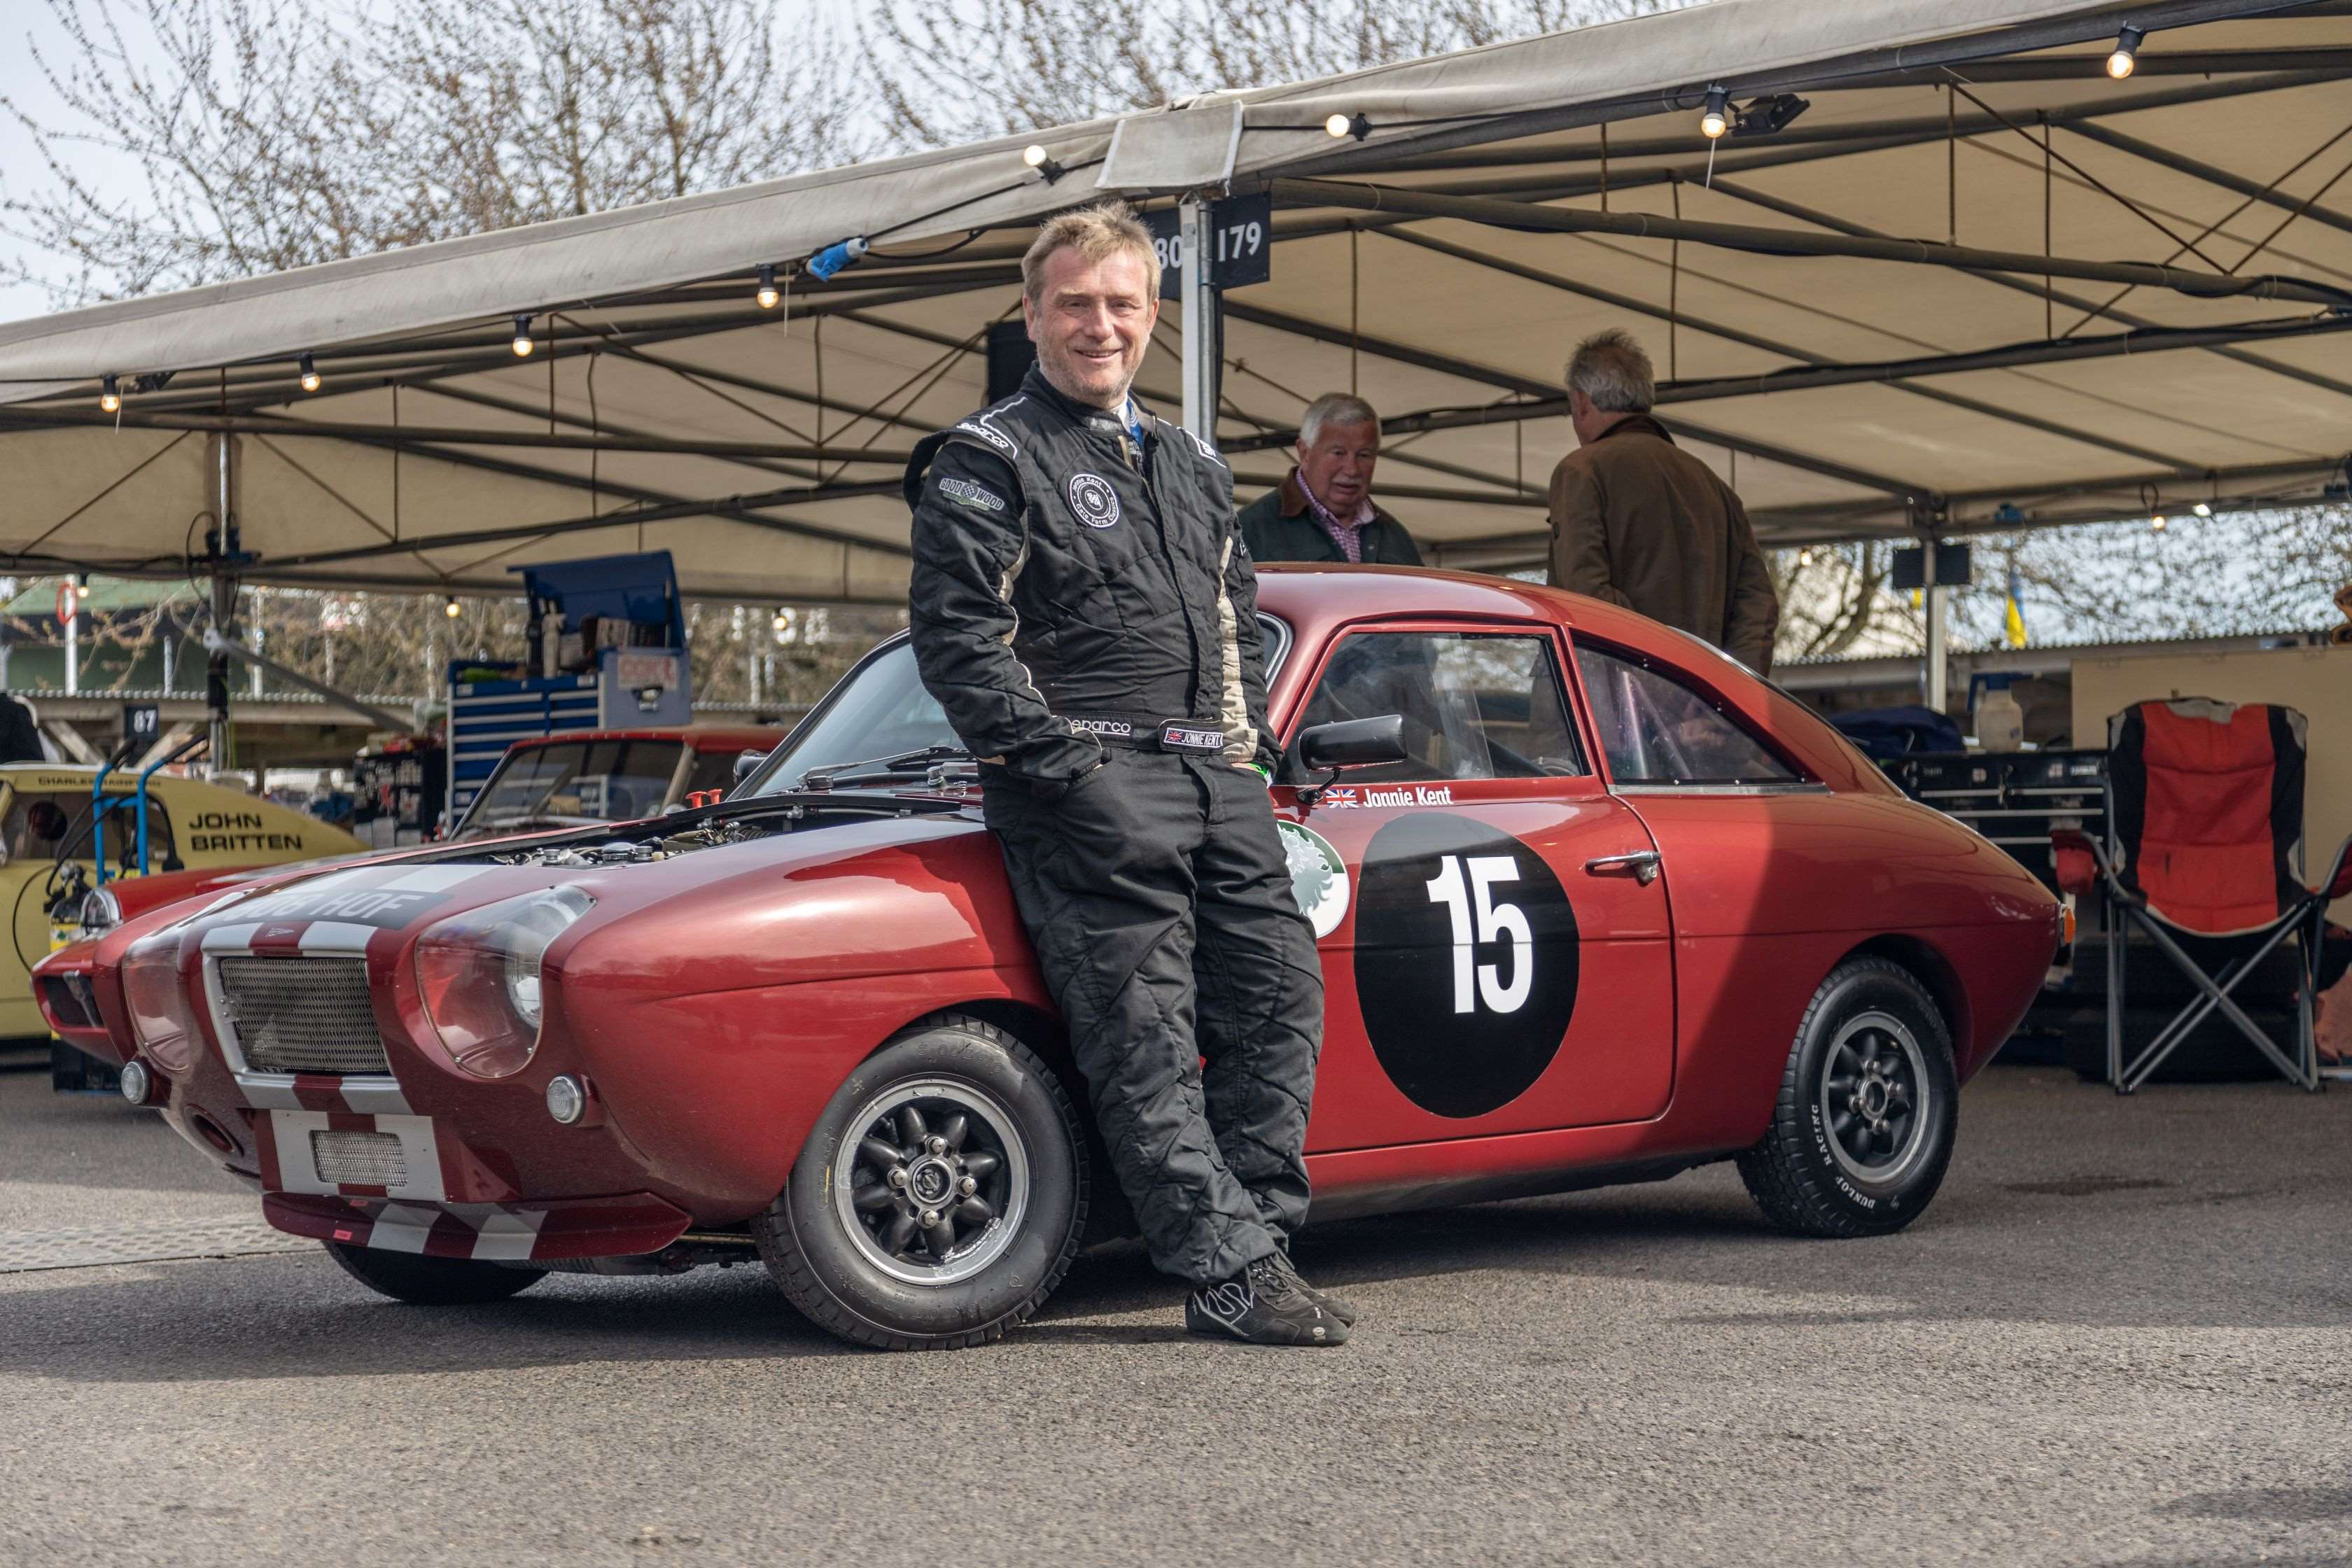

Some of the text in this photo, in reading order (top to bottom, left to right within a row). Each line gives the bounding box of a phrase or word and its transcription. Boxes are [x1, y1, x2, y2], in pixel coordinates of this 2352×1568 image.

[1218, 222, 1262, 262] 179
[940, 479, 962, 493] GOOD
[976, 490, 1002, 509] WOOD
[134, 709, 158, 734] 87
[1182, 732, 1220, 746] JONNIE KENT
[1363, 786, 1454, 808] Jonnie Kent
[189, 813, 262, 830] JOHN
[191, 834, 302, 851] BRITTEN
[308, 892, 424, 919] HOF
[1426, 855, 1533, 1014] 15
[1812, 1104, 1833, 1166] RACING
